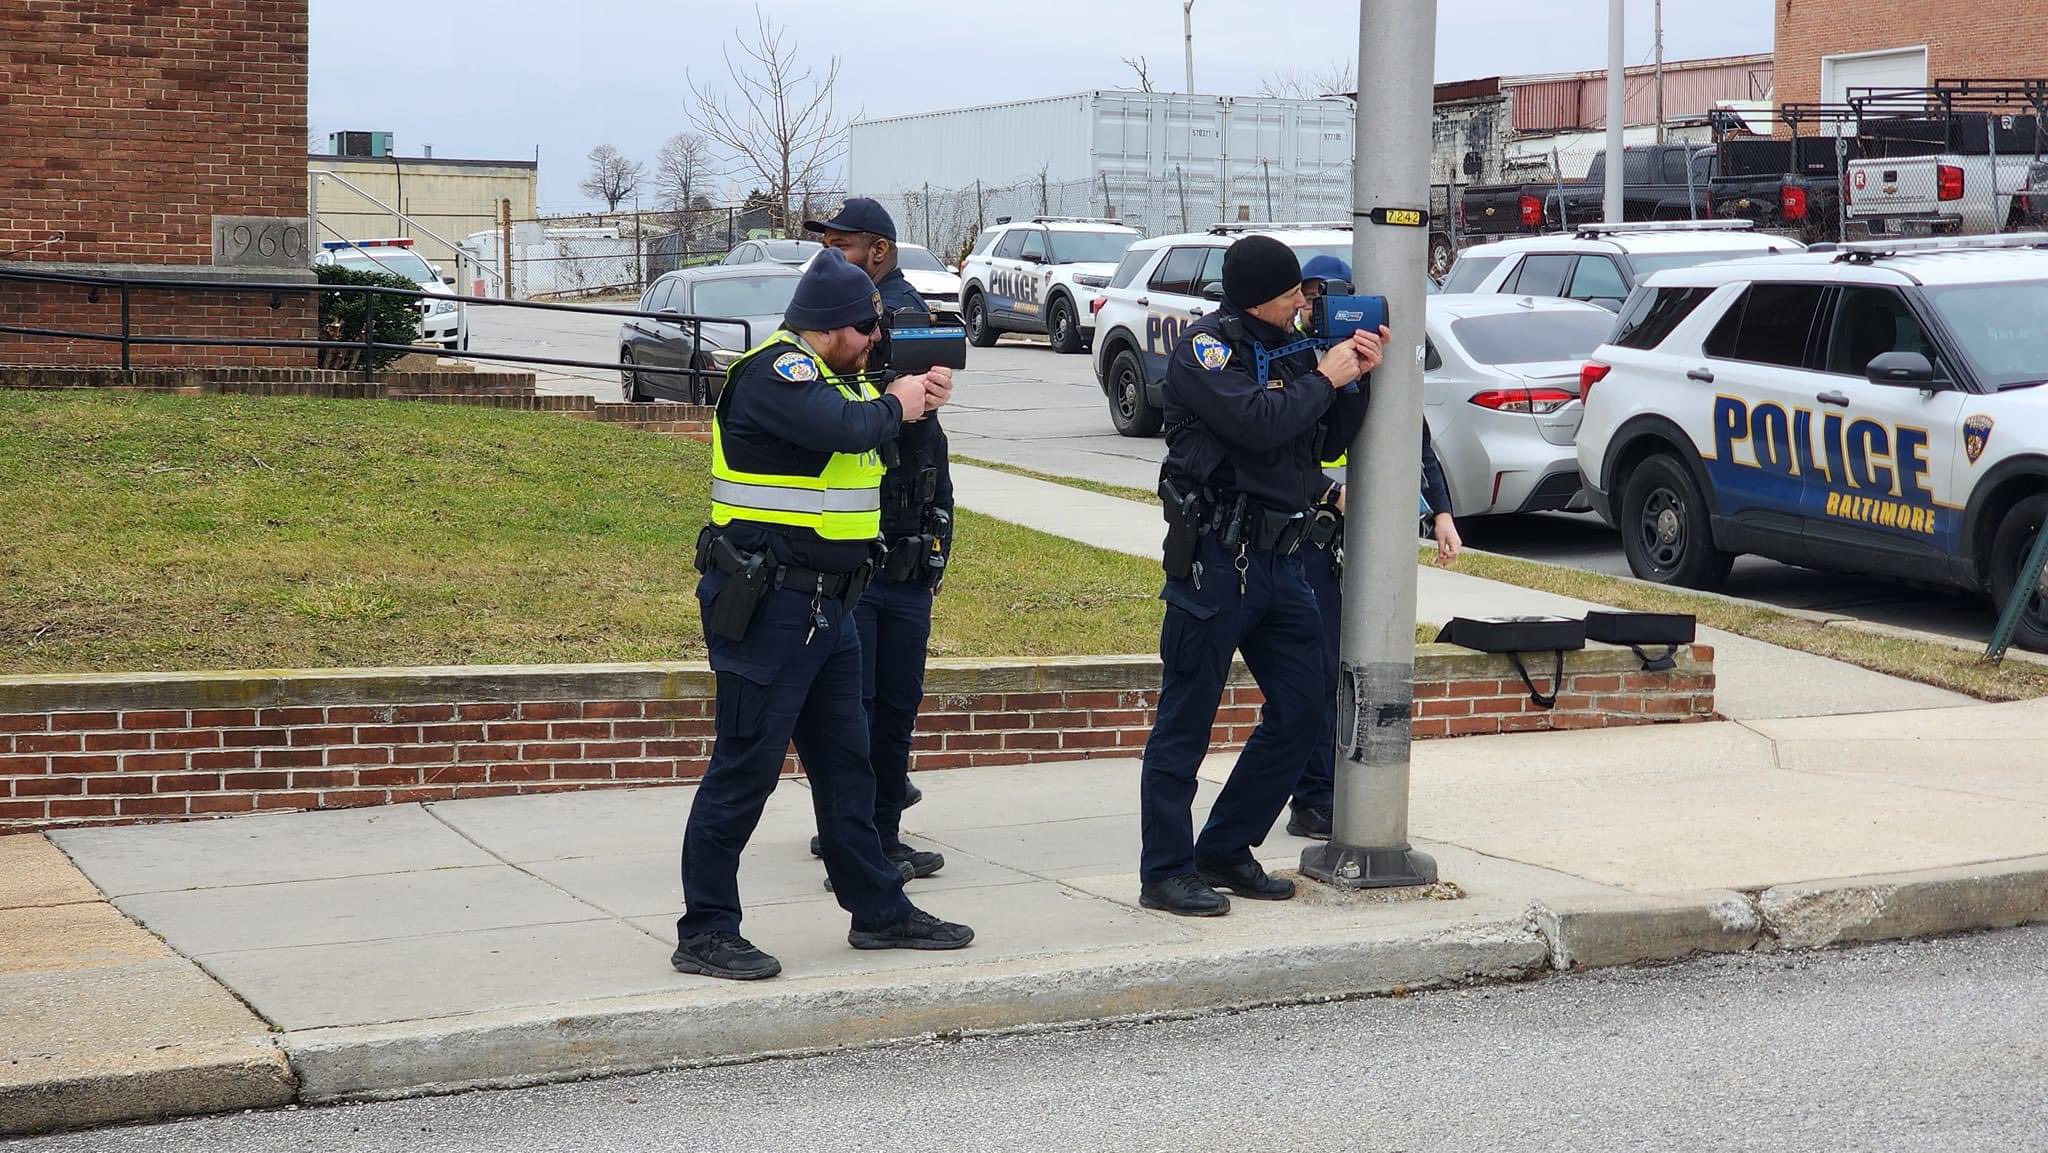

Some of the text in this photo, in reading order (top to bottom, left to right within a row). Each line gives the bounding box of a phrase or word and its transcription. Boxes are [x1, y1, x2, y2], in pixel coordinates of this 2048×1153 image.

[1389, 211, 1419, 223] 7242
[222, 225, 301, 257] 1960
[990, 269, 1039, 302] POLICE
[1714, 393, 1931, 496] POLICE
[1826, 492, 1936, 534] BALTIMORE
